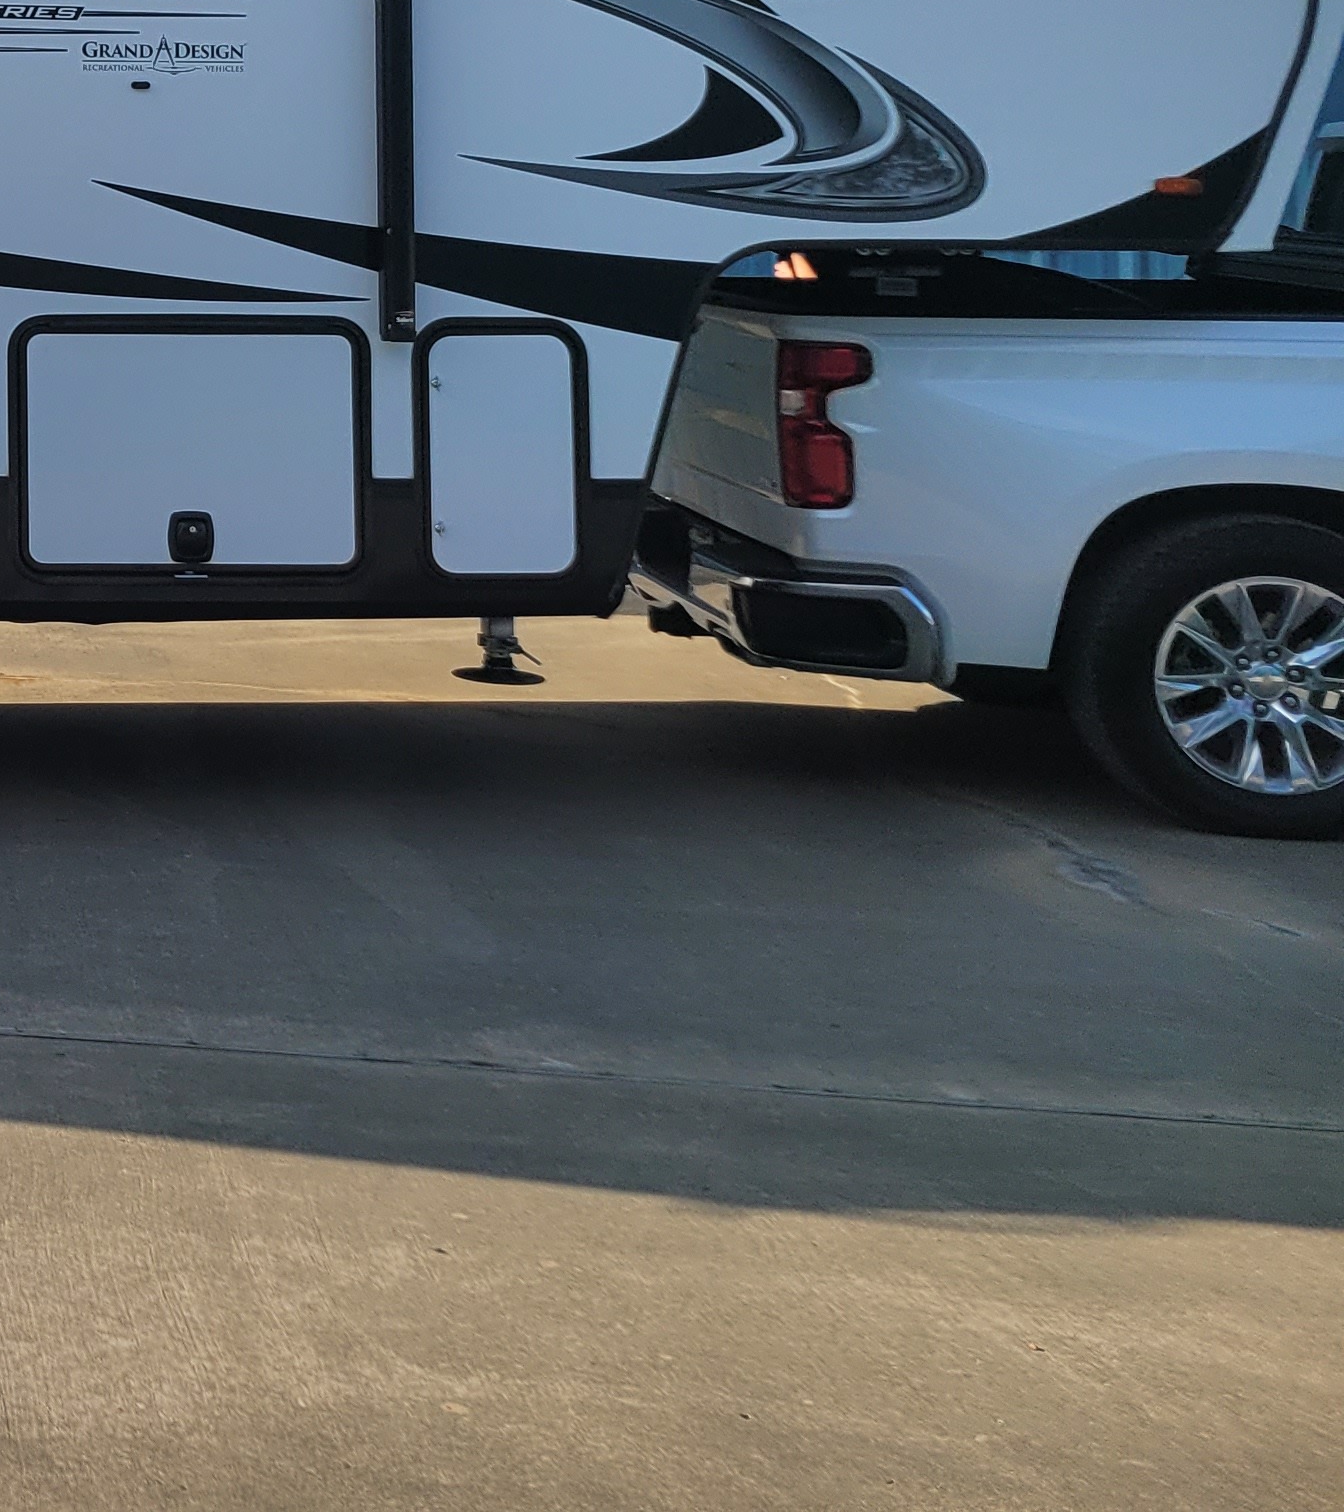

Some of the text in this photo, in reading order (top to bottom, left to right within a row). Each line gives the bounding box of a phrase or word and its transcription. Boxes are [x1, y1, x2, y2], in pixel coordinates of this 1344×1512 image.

[81, 41, 245, 60] GRAND DESIGN
[82, 63, 245, 73] RECREATIONAL VEHICLES
